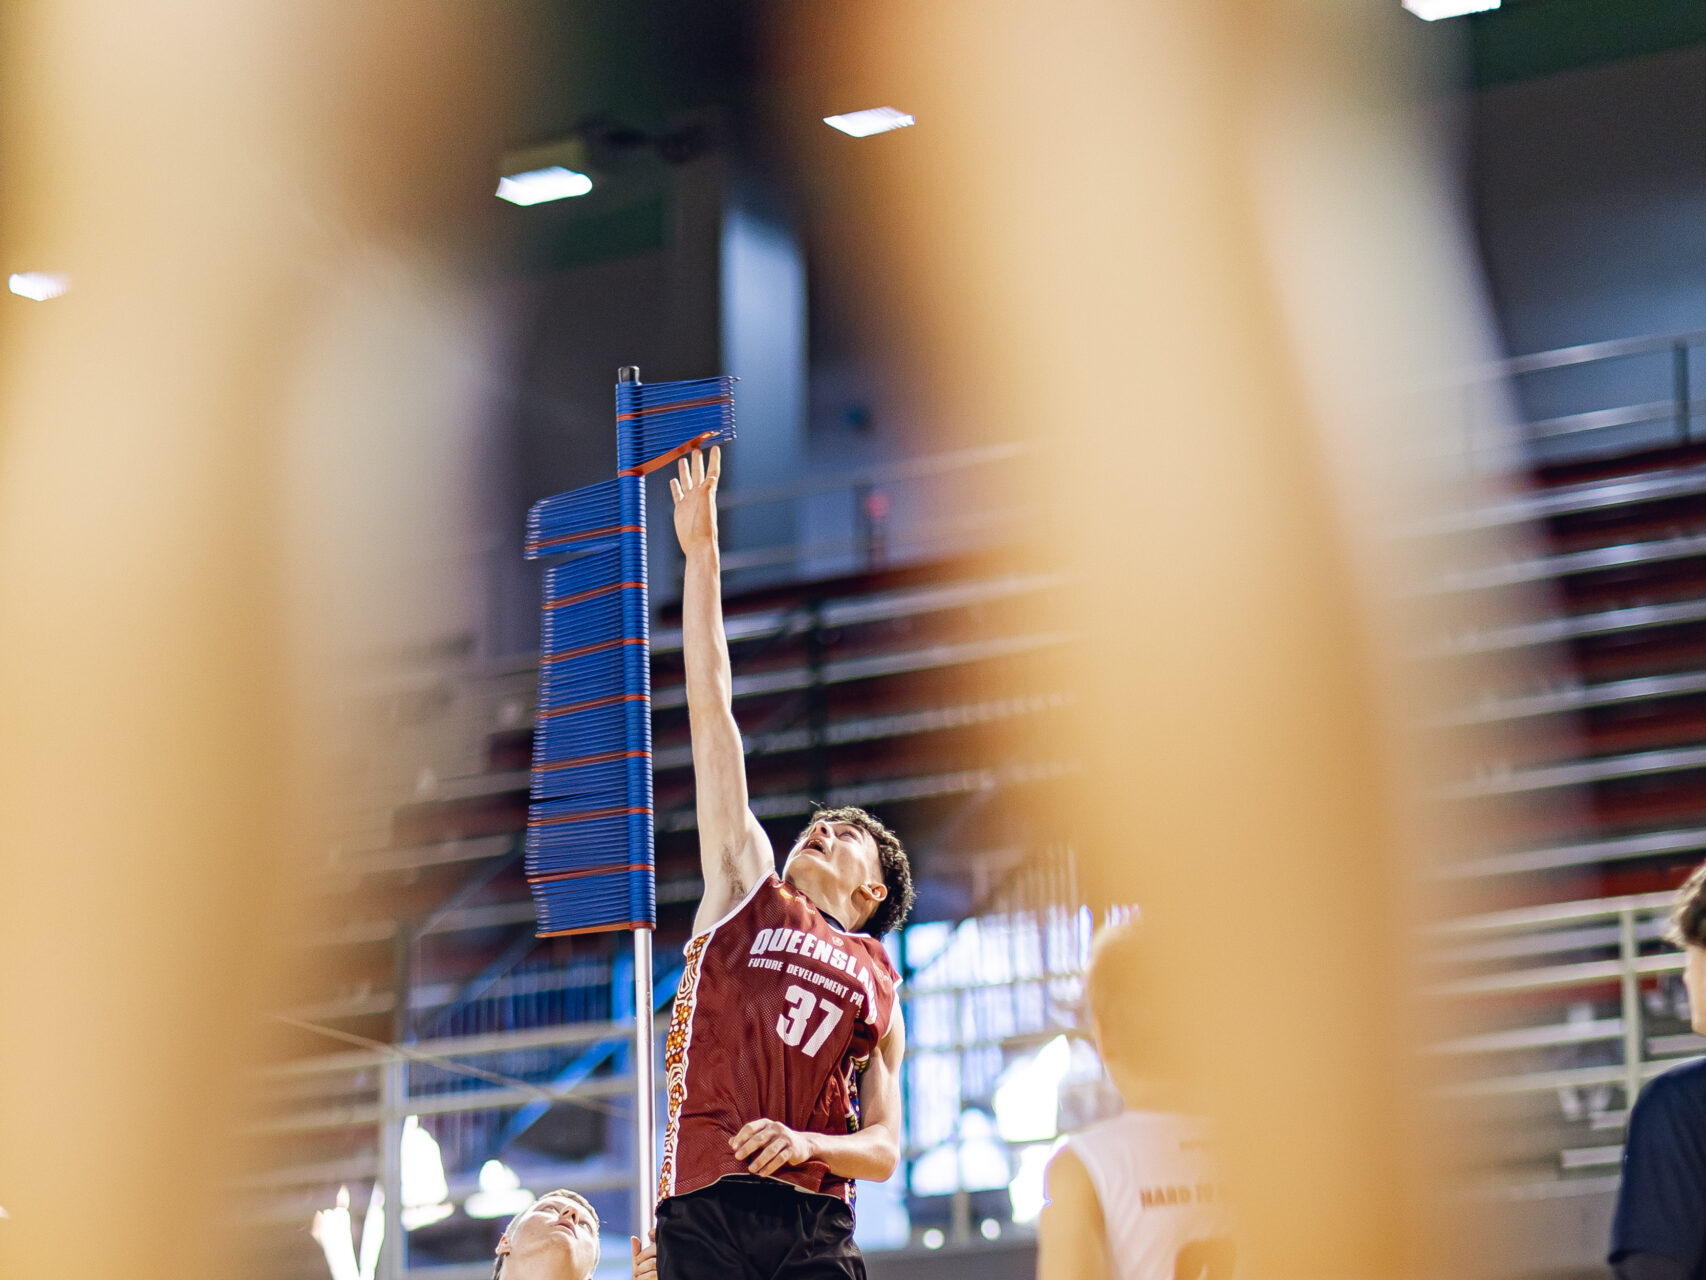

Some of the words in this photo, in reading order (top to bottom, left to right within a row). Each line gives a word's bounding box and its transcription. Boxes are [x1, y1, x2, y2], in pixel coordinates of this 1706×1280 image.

[748, 958, 783, 971] FUTURE
[786, 964, 849, 999] DEVELOPMENT
[776, 984, 843, 1058] 37
